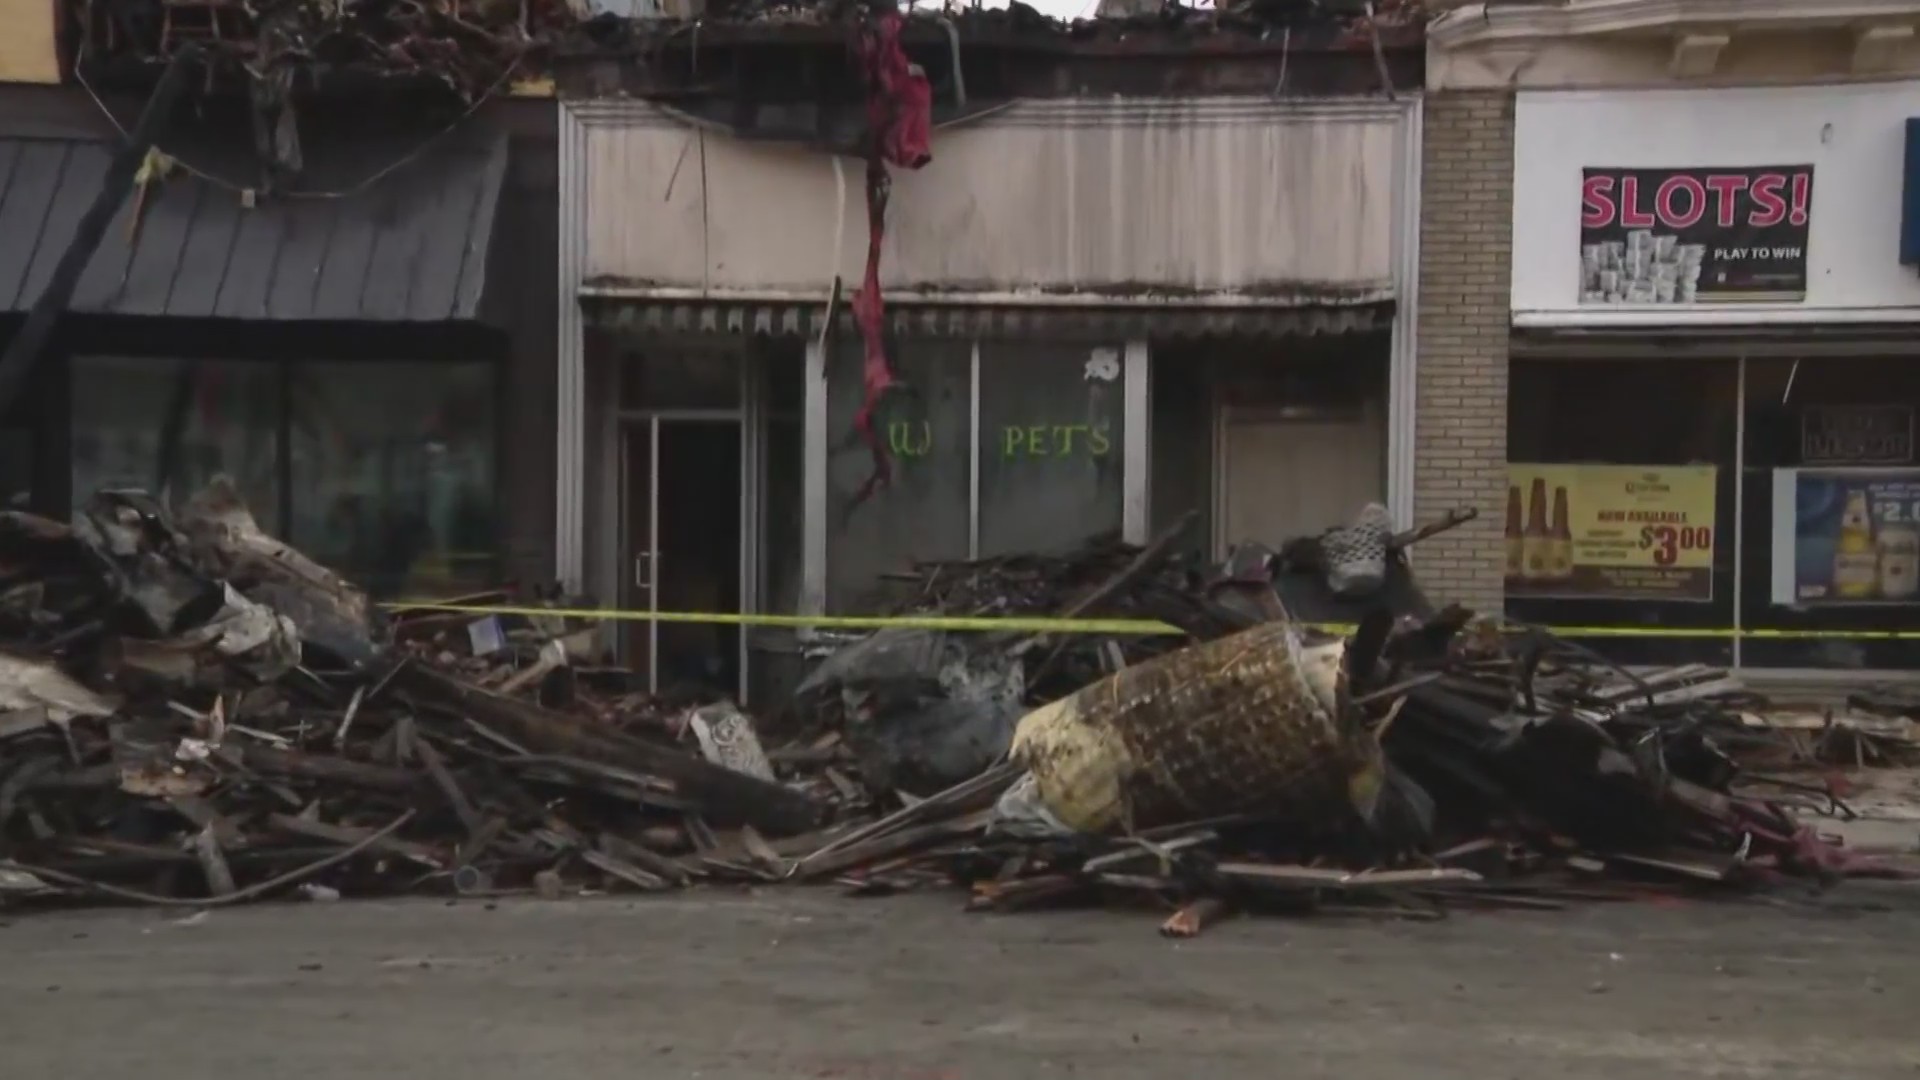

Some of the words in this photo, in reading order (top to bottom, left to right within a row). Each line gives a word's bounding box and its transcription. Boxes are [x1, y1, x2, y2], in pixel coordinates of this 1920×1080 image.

[1582, 174, 1808, 228] SLOTS!
[1714, 247, 1750, 260] PLAY
[1752, 247, 1770, 259] TO
[1772, 246, 1801, 259] WIN
[1004, 421, 1110, 455] PETS
